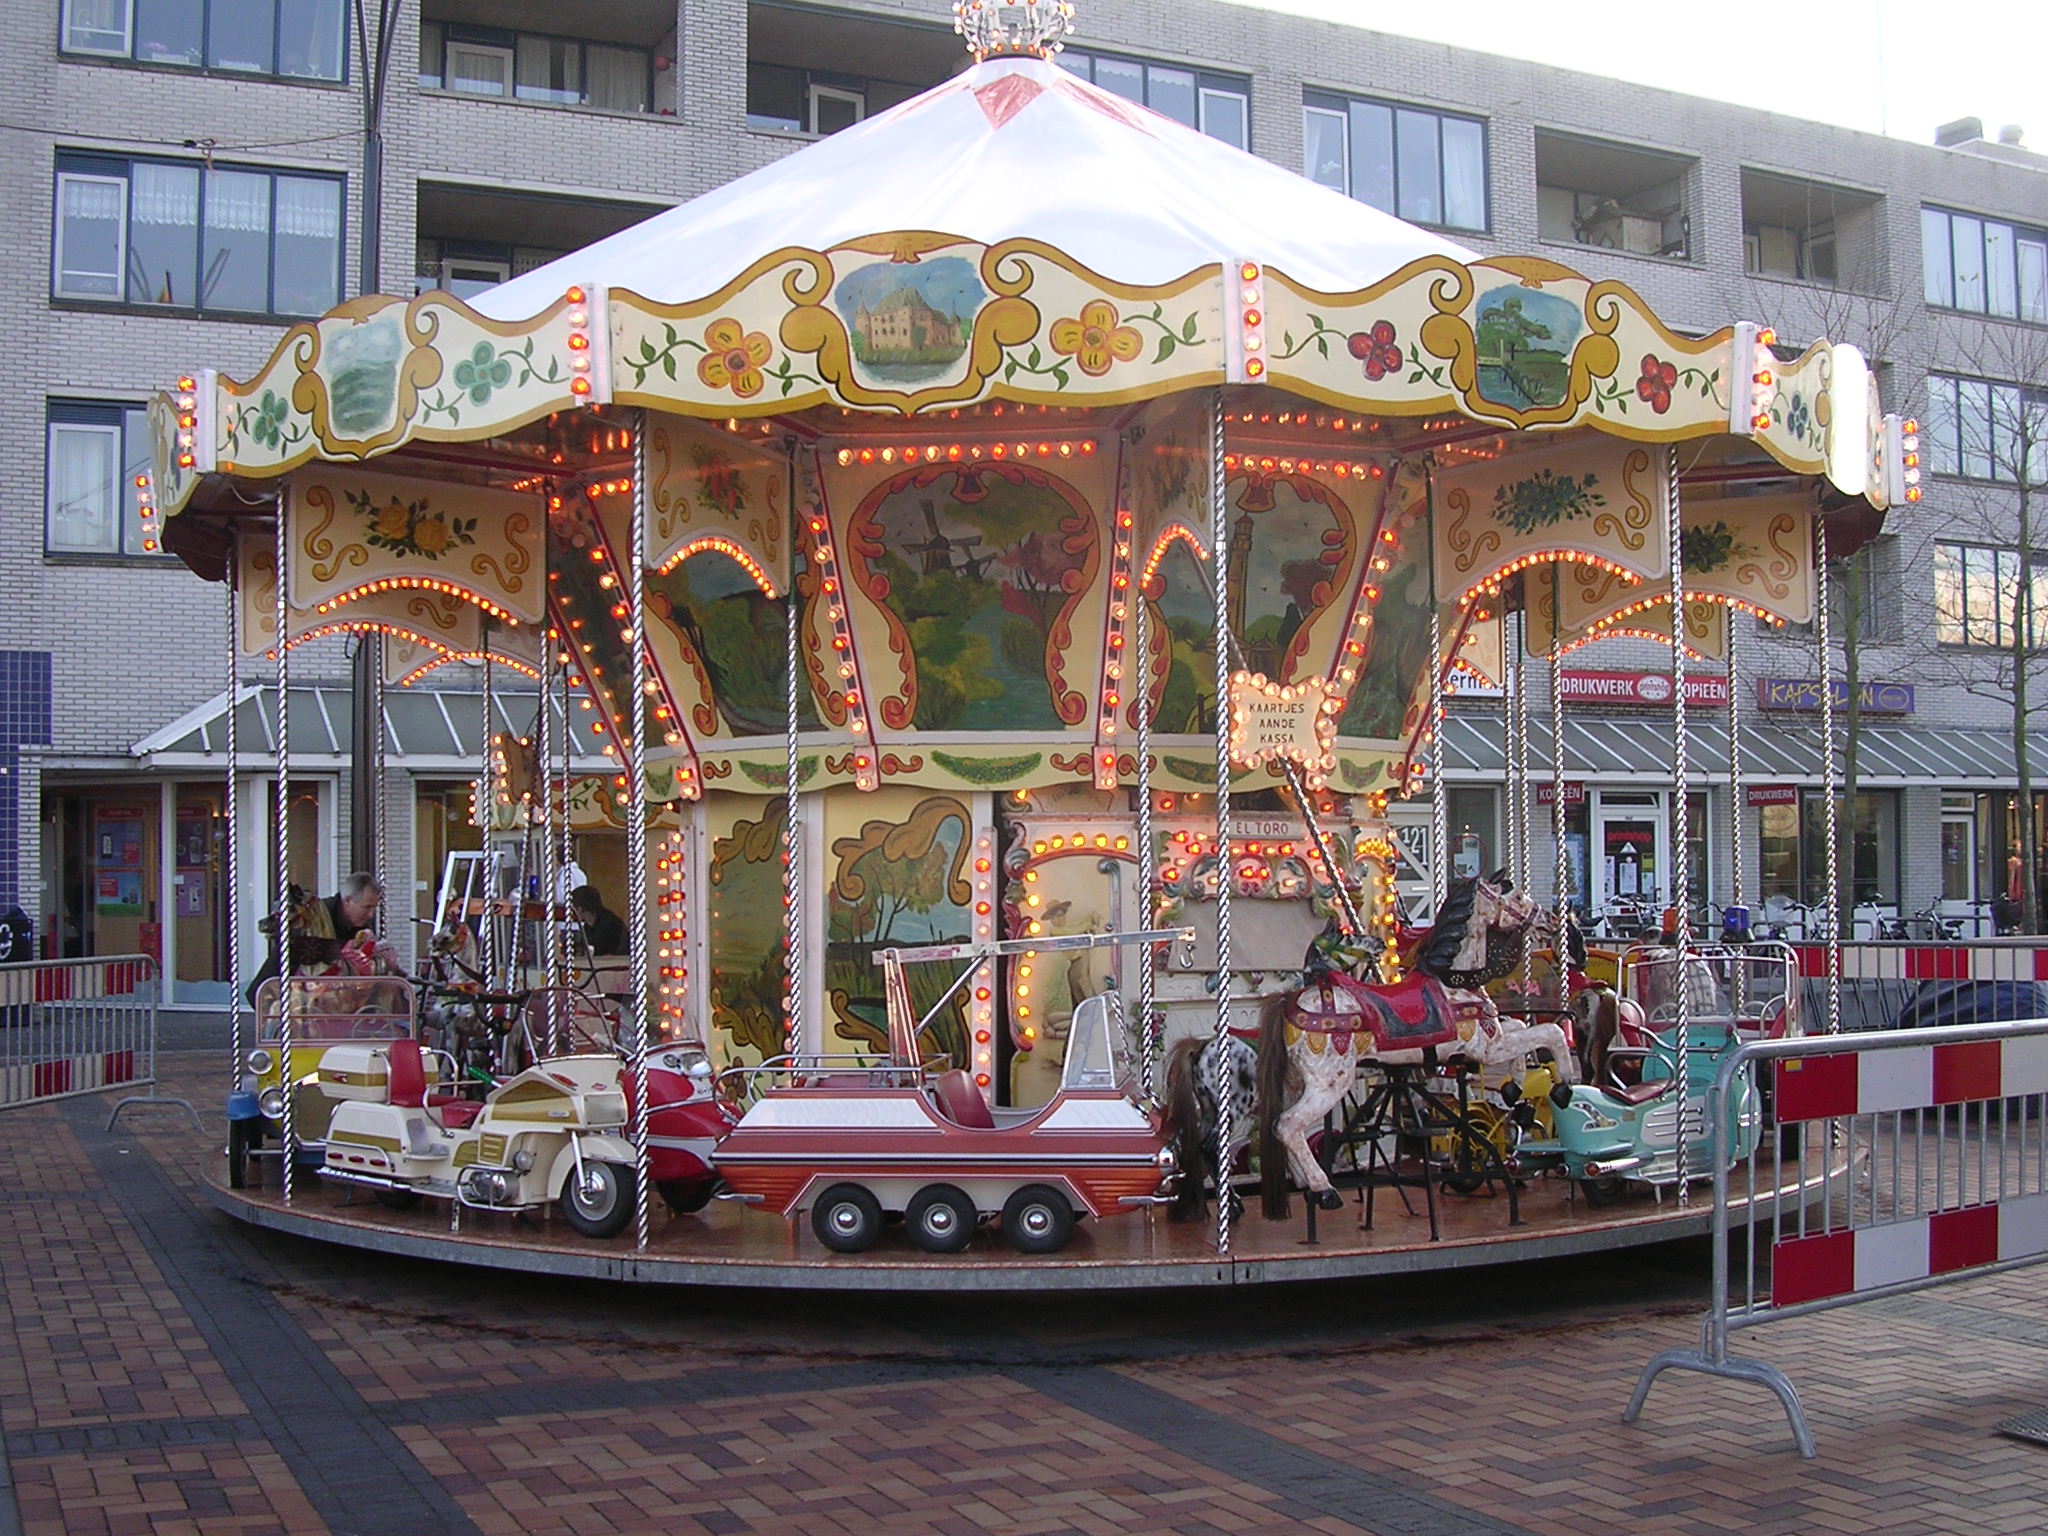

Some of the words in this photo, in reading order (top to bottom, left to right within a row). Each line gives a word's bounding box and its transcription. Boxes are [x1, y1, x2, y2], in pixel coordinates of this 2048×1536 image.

[1561, 677, 1634, 696] DRUKWERK
[1681, 679, 1727, 699] OPIEËN
[1771, 683, 1875, 708] KAPSLN
[1249, 703, 1305, 713] KAARTJES
[1260, 733, 1294, 743] KASSA
[1748, 789, 1794, 801] DRUKWERK
[1236, 822, 1250, 834] EL
[1255, 822, 1289, 835] TORO
